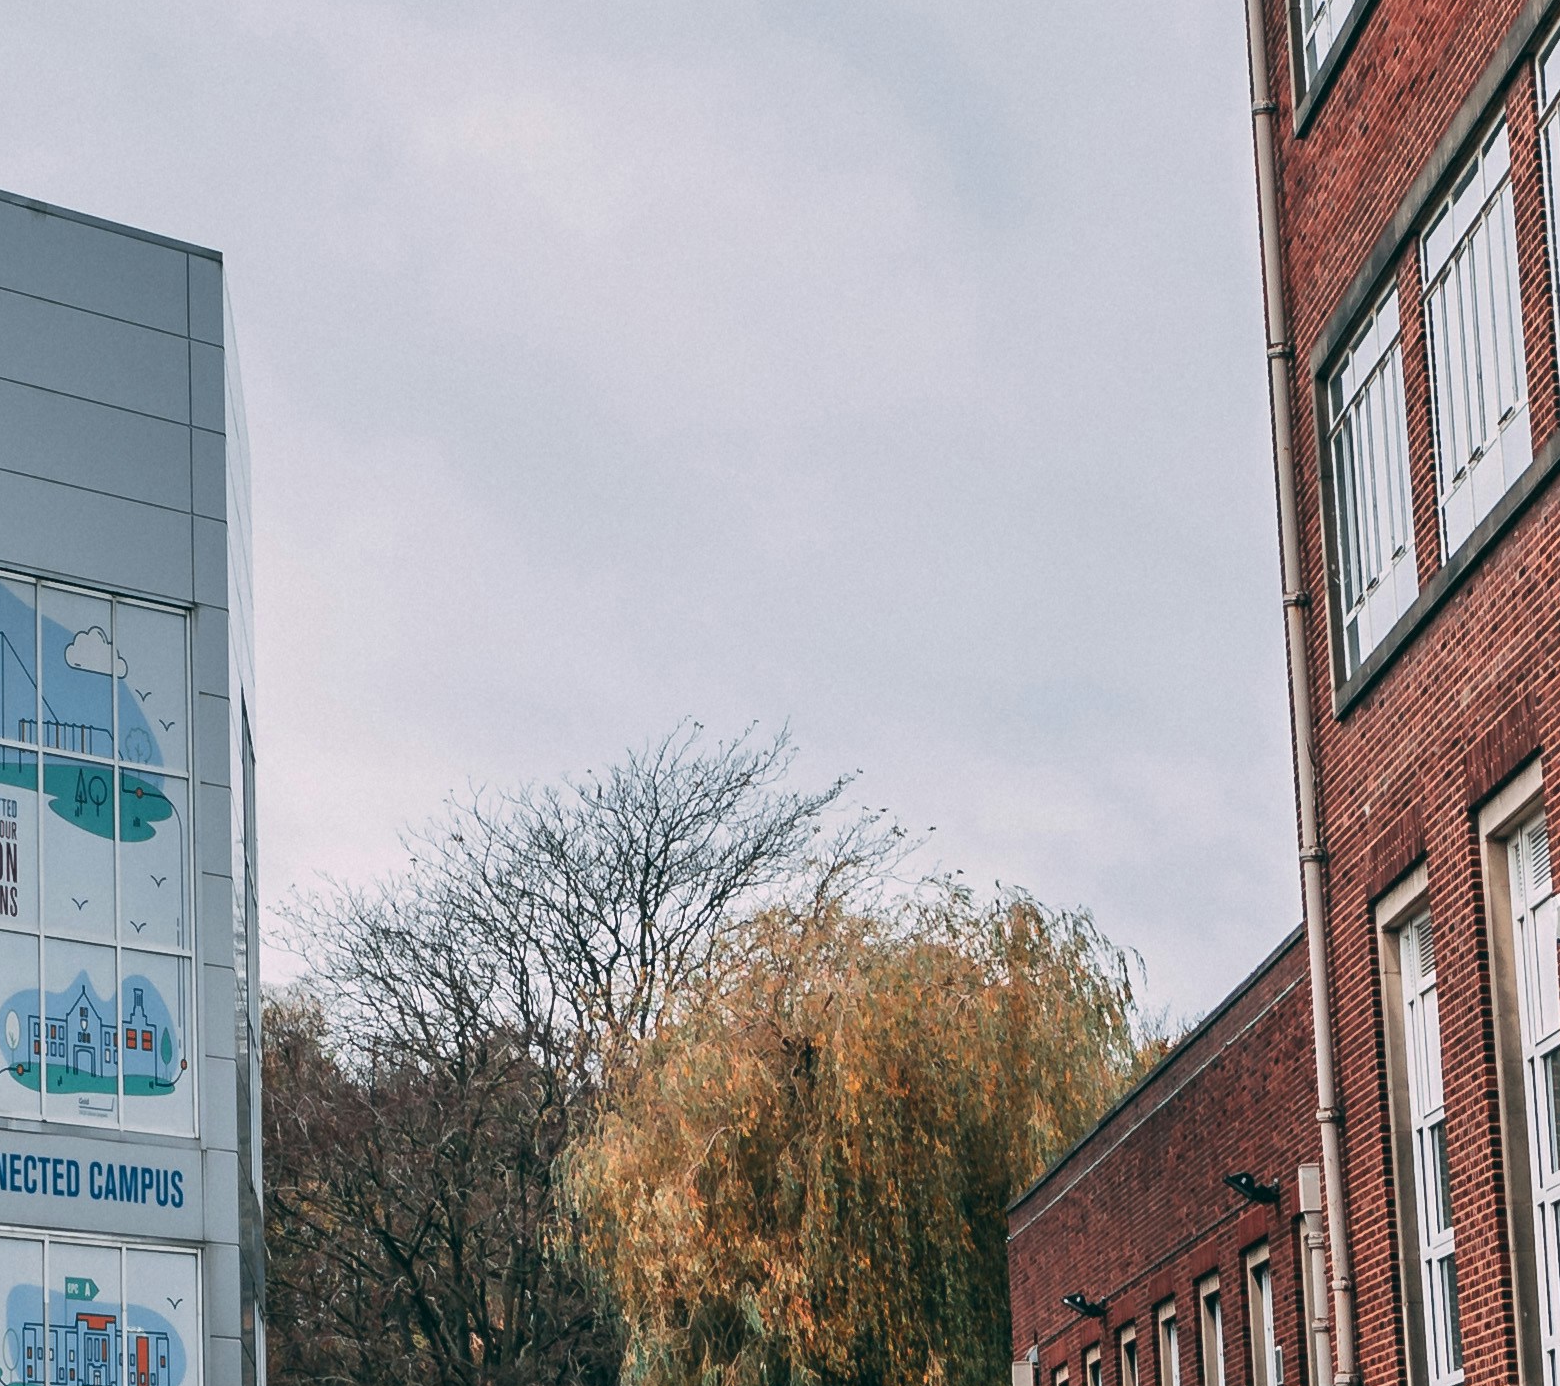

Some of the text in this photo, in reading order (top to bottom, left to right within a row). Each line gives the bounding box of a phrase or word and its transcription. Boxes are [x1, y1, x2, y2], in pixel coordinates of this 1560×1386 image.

[0, 819, 17, 841] OUR
[89, 1161, 184, 1208] CAMPUS
[84, 1282, 90, 1296] A
